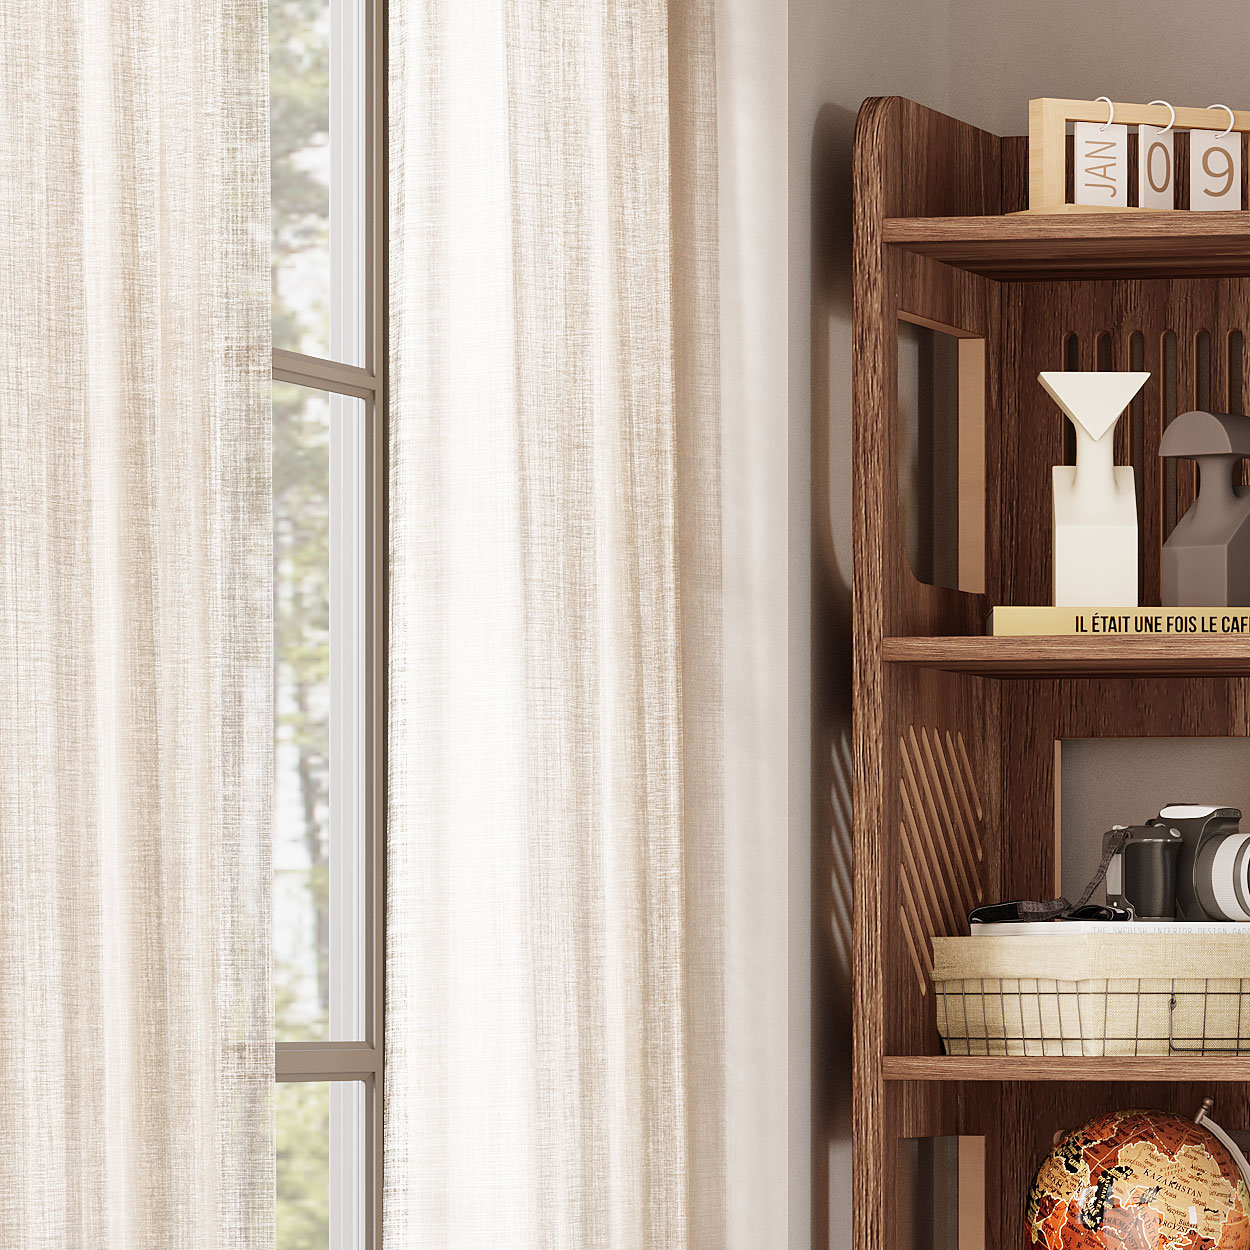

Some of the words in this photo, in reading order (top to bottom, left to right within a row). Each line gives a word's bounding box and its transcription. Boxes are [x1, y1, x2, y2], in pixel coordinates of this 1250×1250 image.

[1084, 140, 1117, 198] JAN
[1075, 615, 1088, 633] IL
[1092, 612, 1131, 633] ÉTAIT
[1134, 615, 1163, 633] UNE
[1166, 615, 1197, 633] FOIS
[1201, 615, 1218, 633] LE
[1143, 1168, 1204, 1198] KAZAKHSTAN
